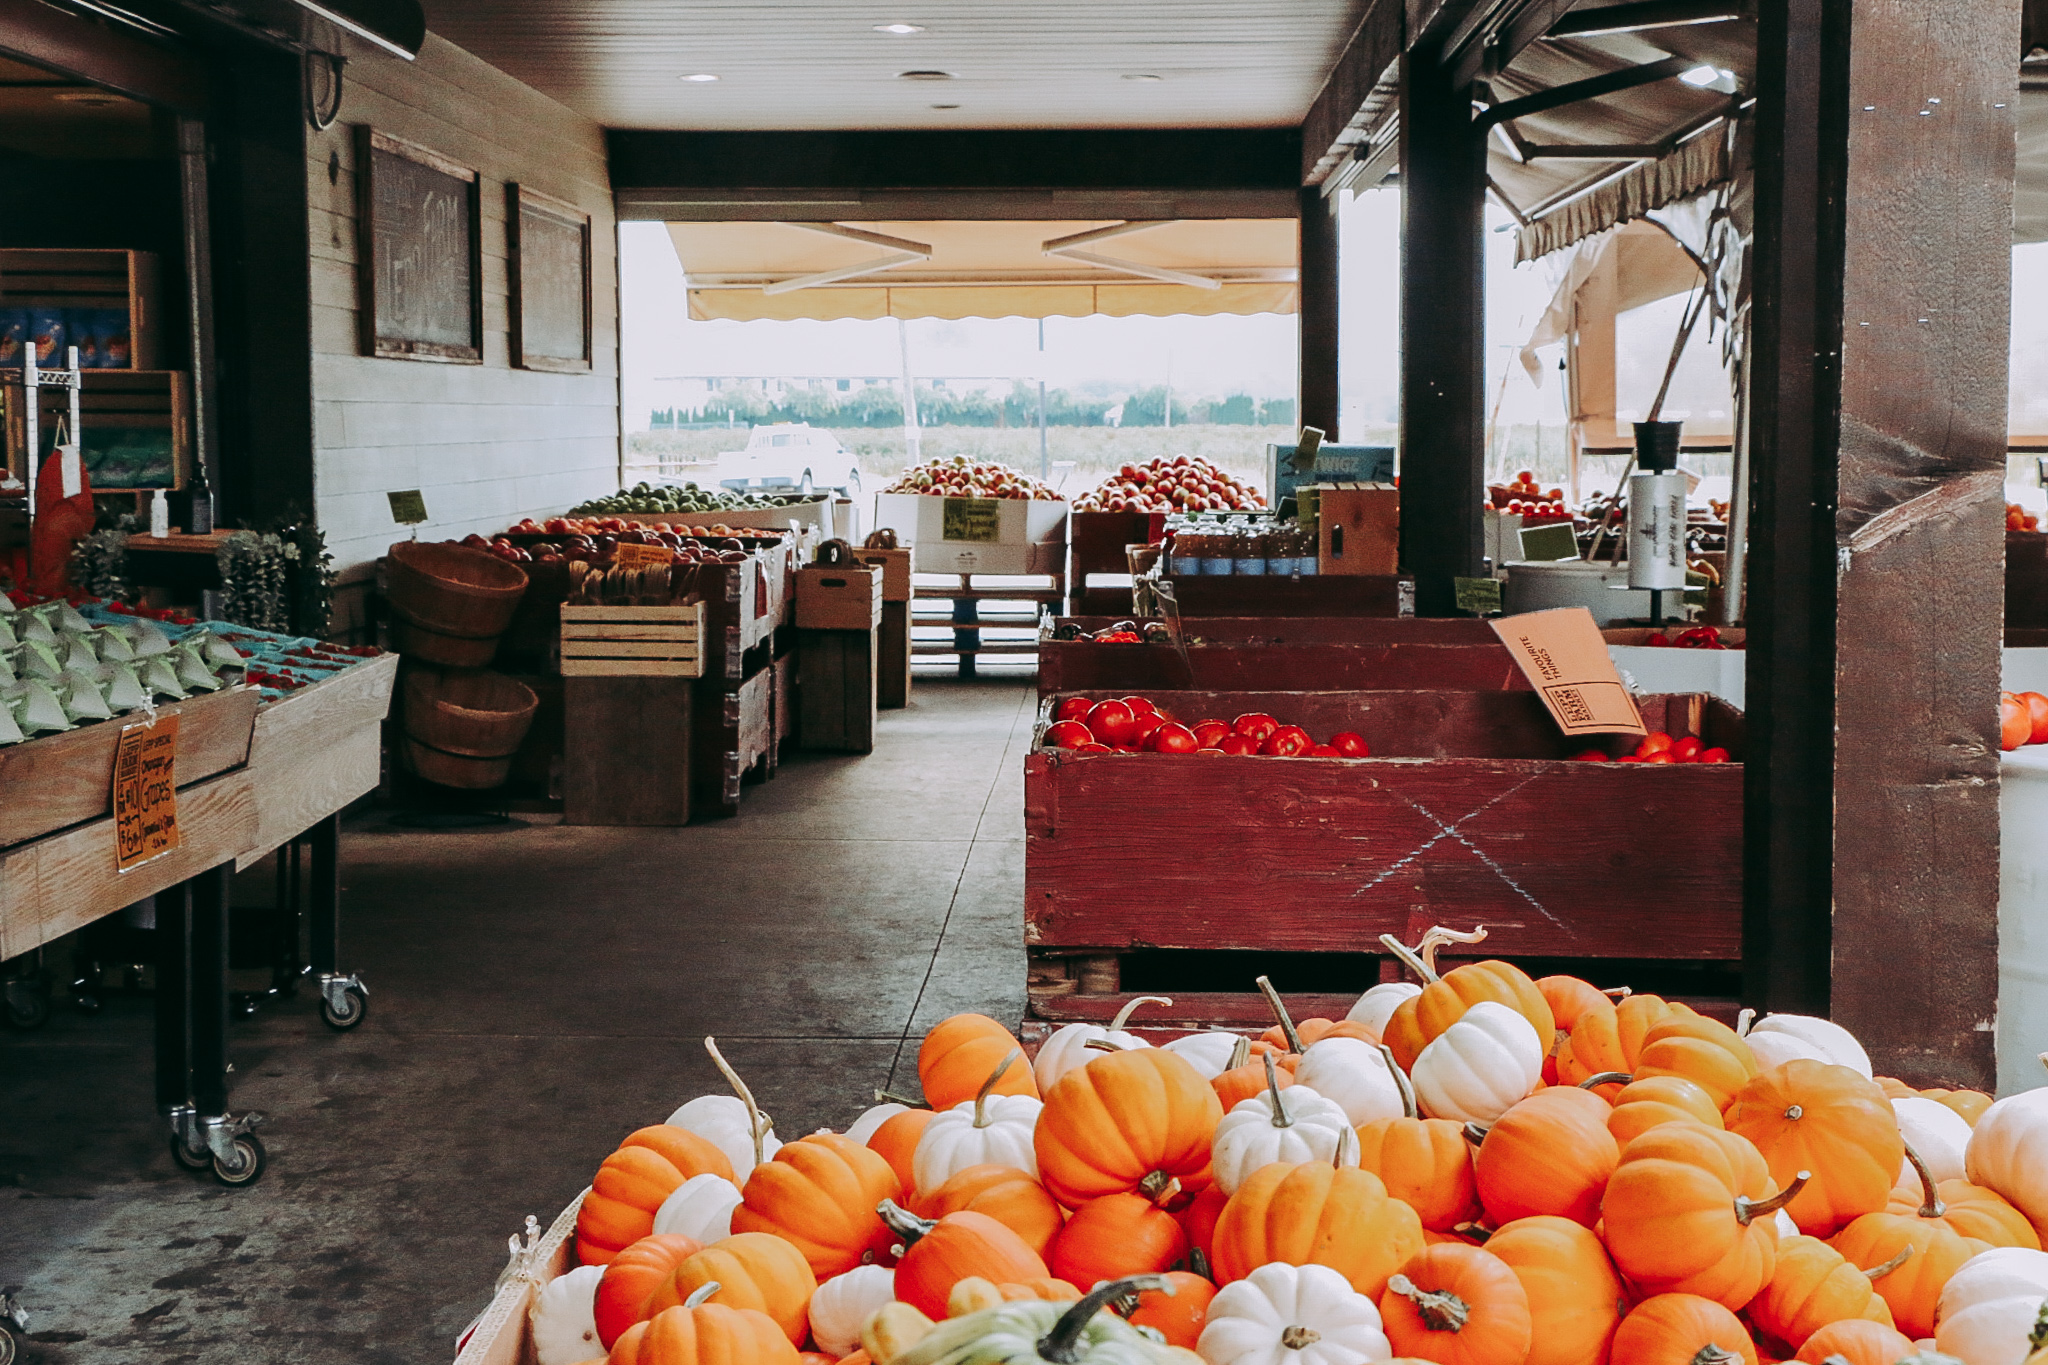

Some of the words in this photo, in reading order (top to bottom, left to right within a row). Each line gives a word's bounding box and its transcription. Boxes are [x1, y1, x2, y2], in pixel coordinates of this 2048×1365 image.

[1519, 635, 1553, 681] FAVOURITE
[1538, 648, 1562, 679] THINGS
[1554, 690, 1578, 722] LEPP
[1561, 689, 1586, 721] FARM
[1569, 688, 1592, 721] MARKET
[141, 777, 171, 813] Grapes
